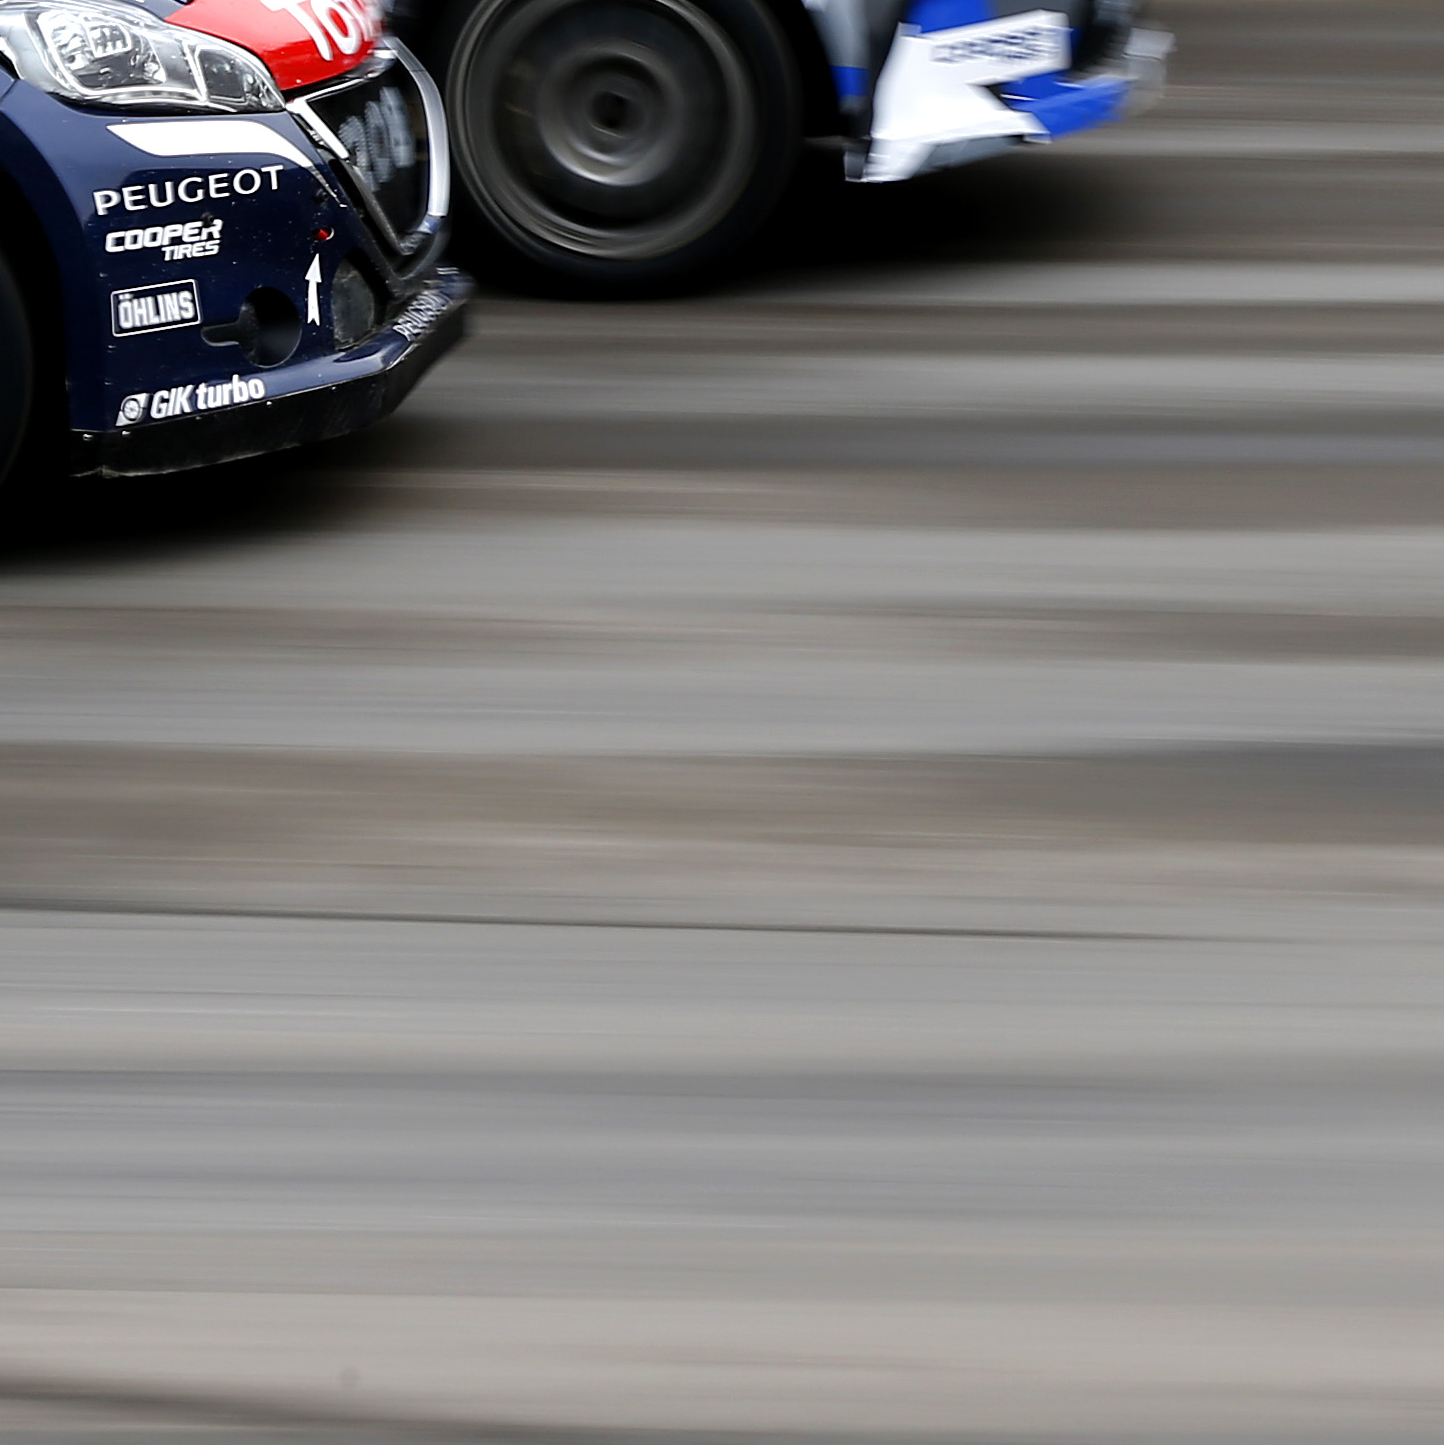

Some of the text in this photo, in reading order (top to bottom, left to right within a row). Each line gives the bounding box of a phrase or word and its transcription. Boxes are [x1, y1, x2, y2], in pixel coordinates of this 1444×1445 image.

[92, 164, 284, 216] PEUGEOT
[104, 218, 223, 253] COOPER
[161, 240, 220, 260] TIRES
[118, 289, 195, 329] ÖHLINS
[195, 373, 266, 410] turbo
